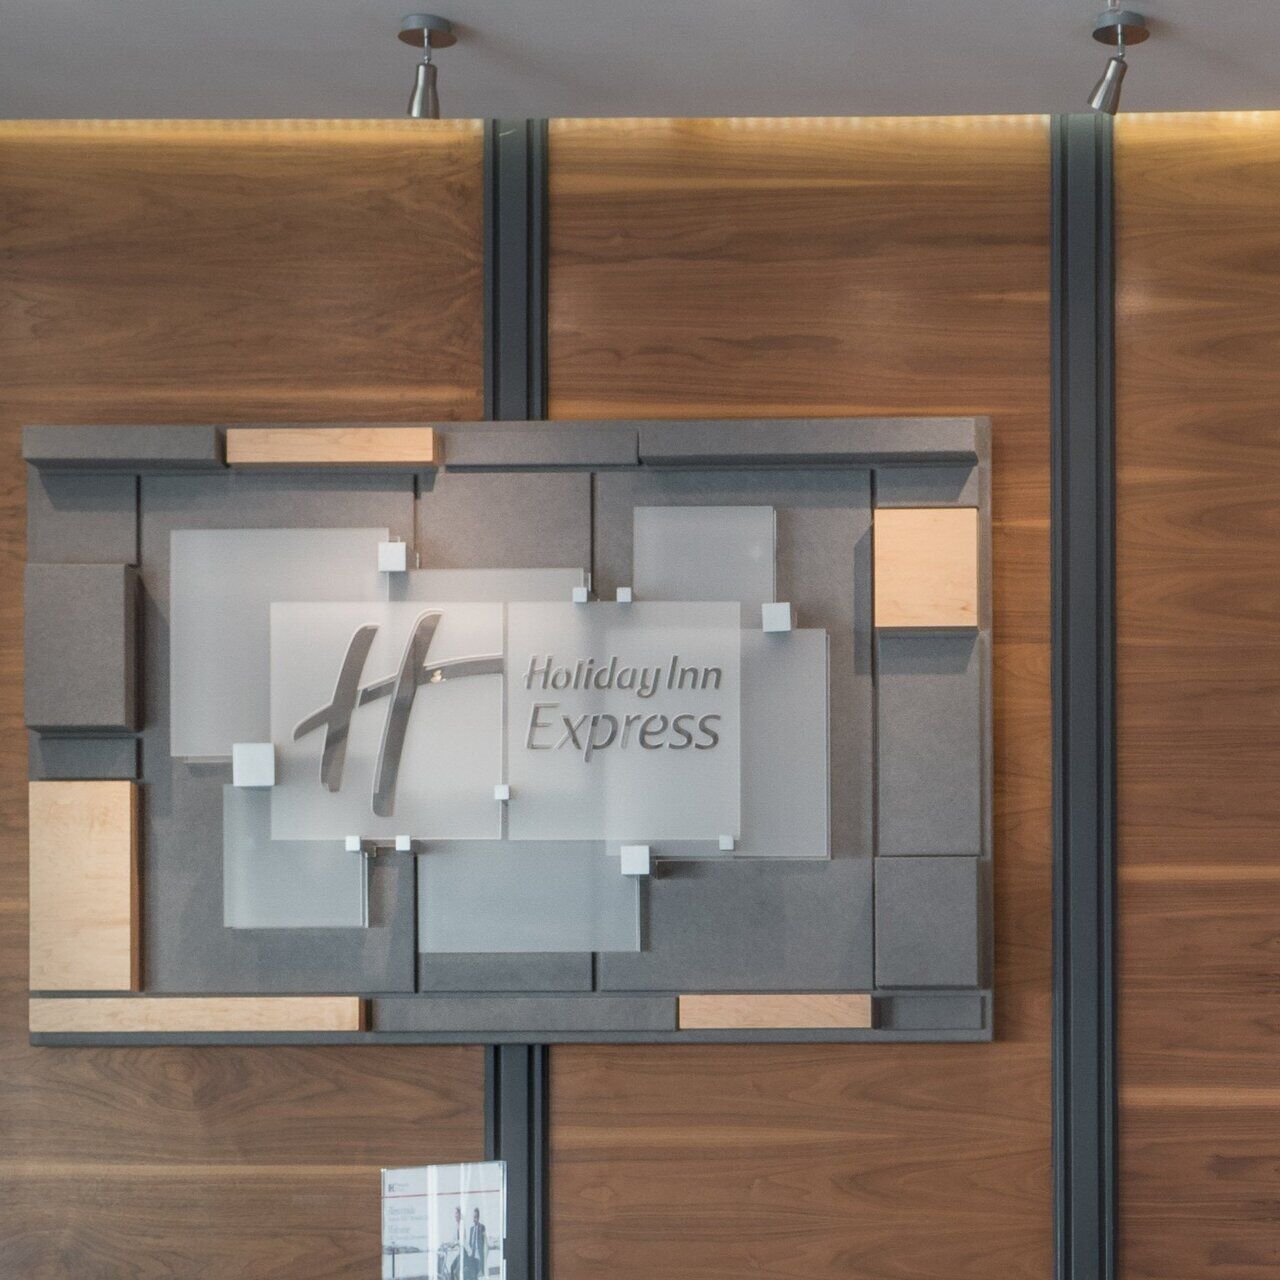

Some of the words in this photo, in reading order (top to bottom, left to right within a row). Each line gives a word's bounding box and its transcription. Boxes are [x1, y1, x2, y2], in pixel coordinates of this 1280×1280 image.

[523, 655, 661, 698] Holiday
[668, 655, 722, 690] Inn
[525, 702, 721, 762] Express
